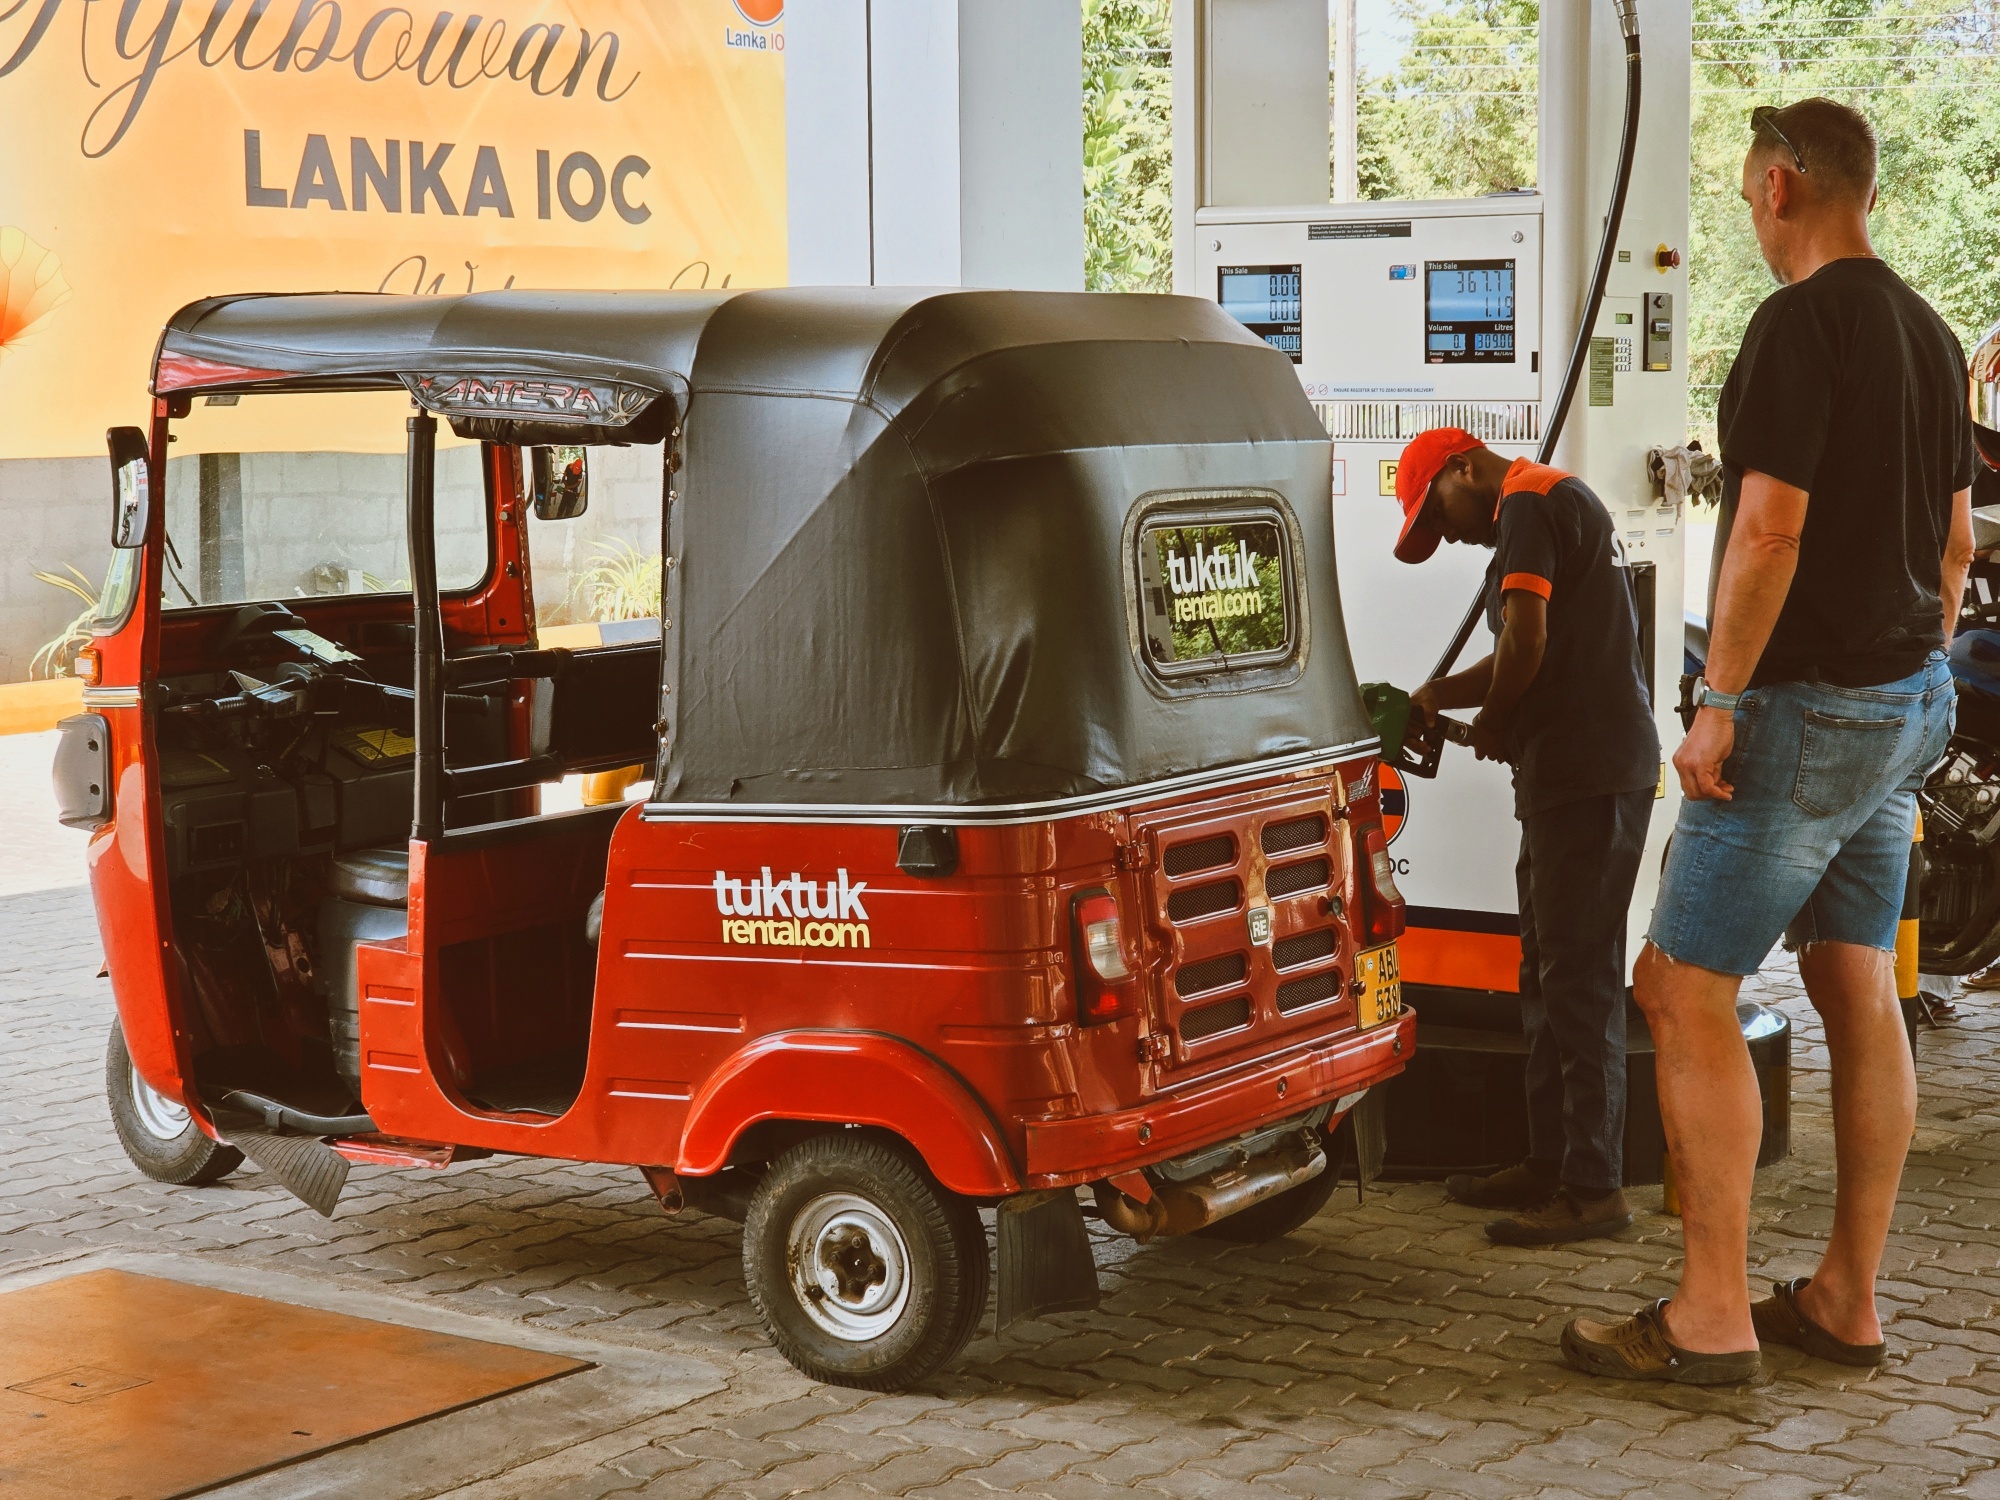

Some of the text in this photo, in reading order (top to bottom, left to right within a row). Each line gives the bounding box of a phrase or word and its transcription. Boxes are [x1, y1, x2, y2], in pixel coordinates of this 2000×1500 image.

[726, 27, 767, 50] Lanka
[243, 128, 653, 225] LANKA IOC
[1221, 267, 1234, 275] This
[1291, 265, 1300, 273] Rs
[1428, 262, 1442, 270] This
[1505, 261, 1514, 269] Rs
[1269, 274, 1300, 296] 0.00
[1269, 299, 1300, 321] 0.00
[1485, 295, 1513, 318] 1.19
[1282, 325, 1301, 333] Litres
[1494, 323, 1514, 331] Litres
[1166, 539, 1260, 594] tuktuk
[1174, 590, 1262, 622] rental.com
[712, 866, 870, 920] tuktuk
[722, 916, 871, 949] rental.com
[1252, 919, 1267, 938] RE
